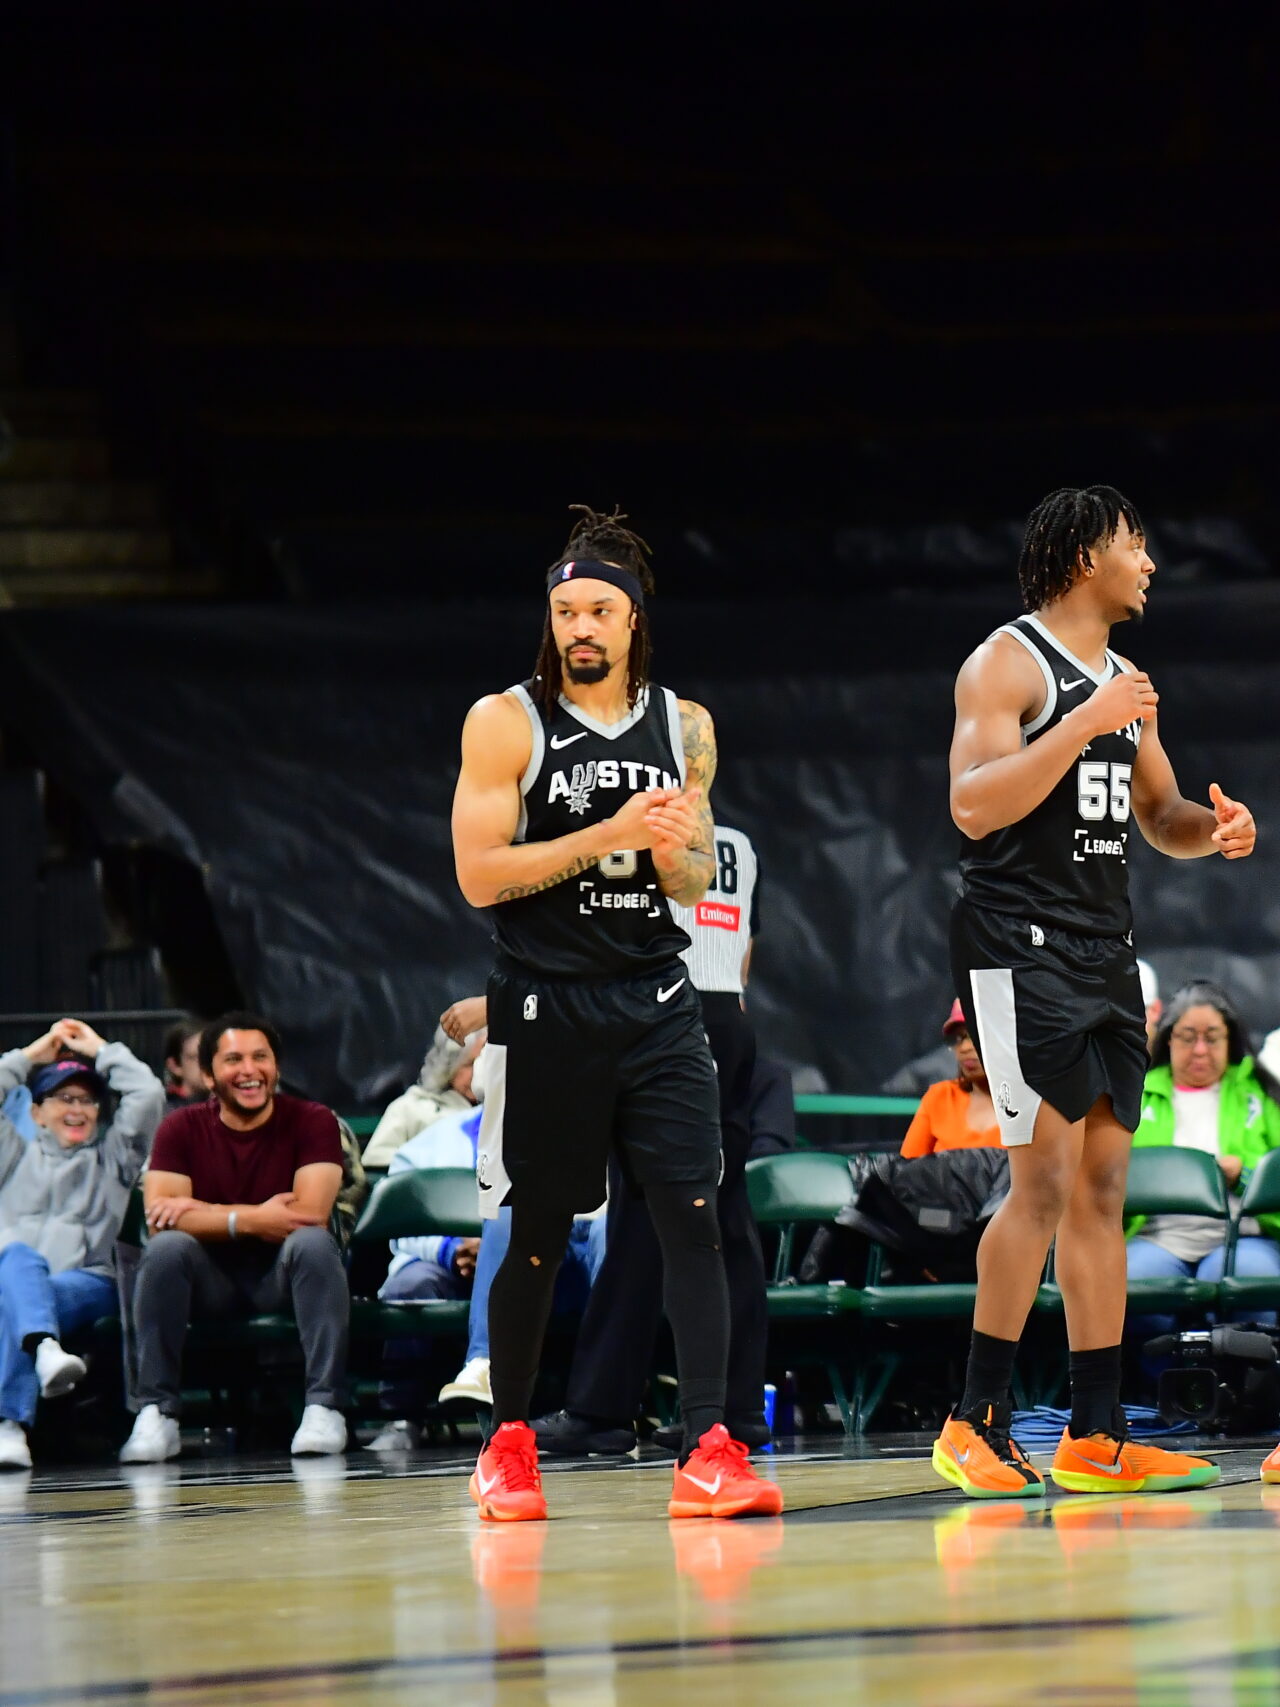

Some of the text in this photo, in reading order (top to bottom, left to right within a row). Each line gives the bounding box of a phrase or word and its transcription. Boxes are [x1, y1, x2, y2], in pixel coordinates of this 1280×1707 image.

[1077, 761, 1133, 823] 55
[709, 840, 738, 894] 8
[589, 891, 651, 909] LEDGER
